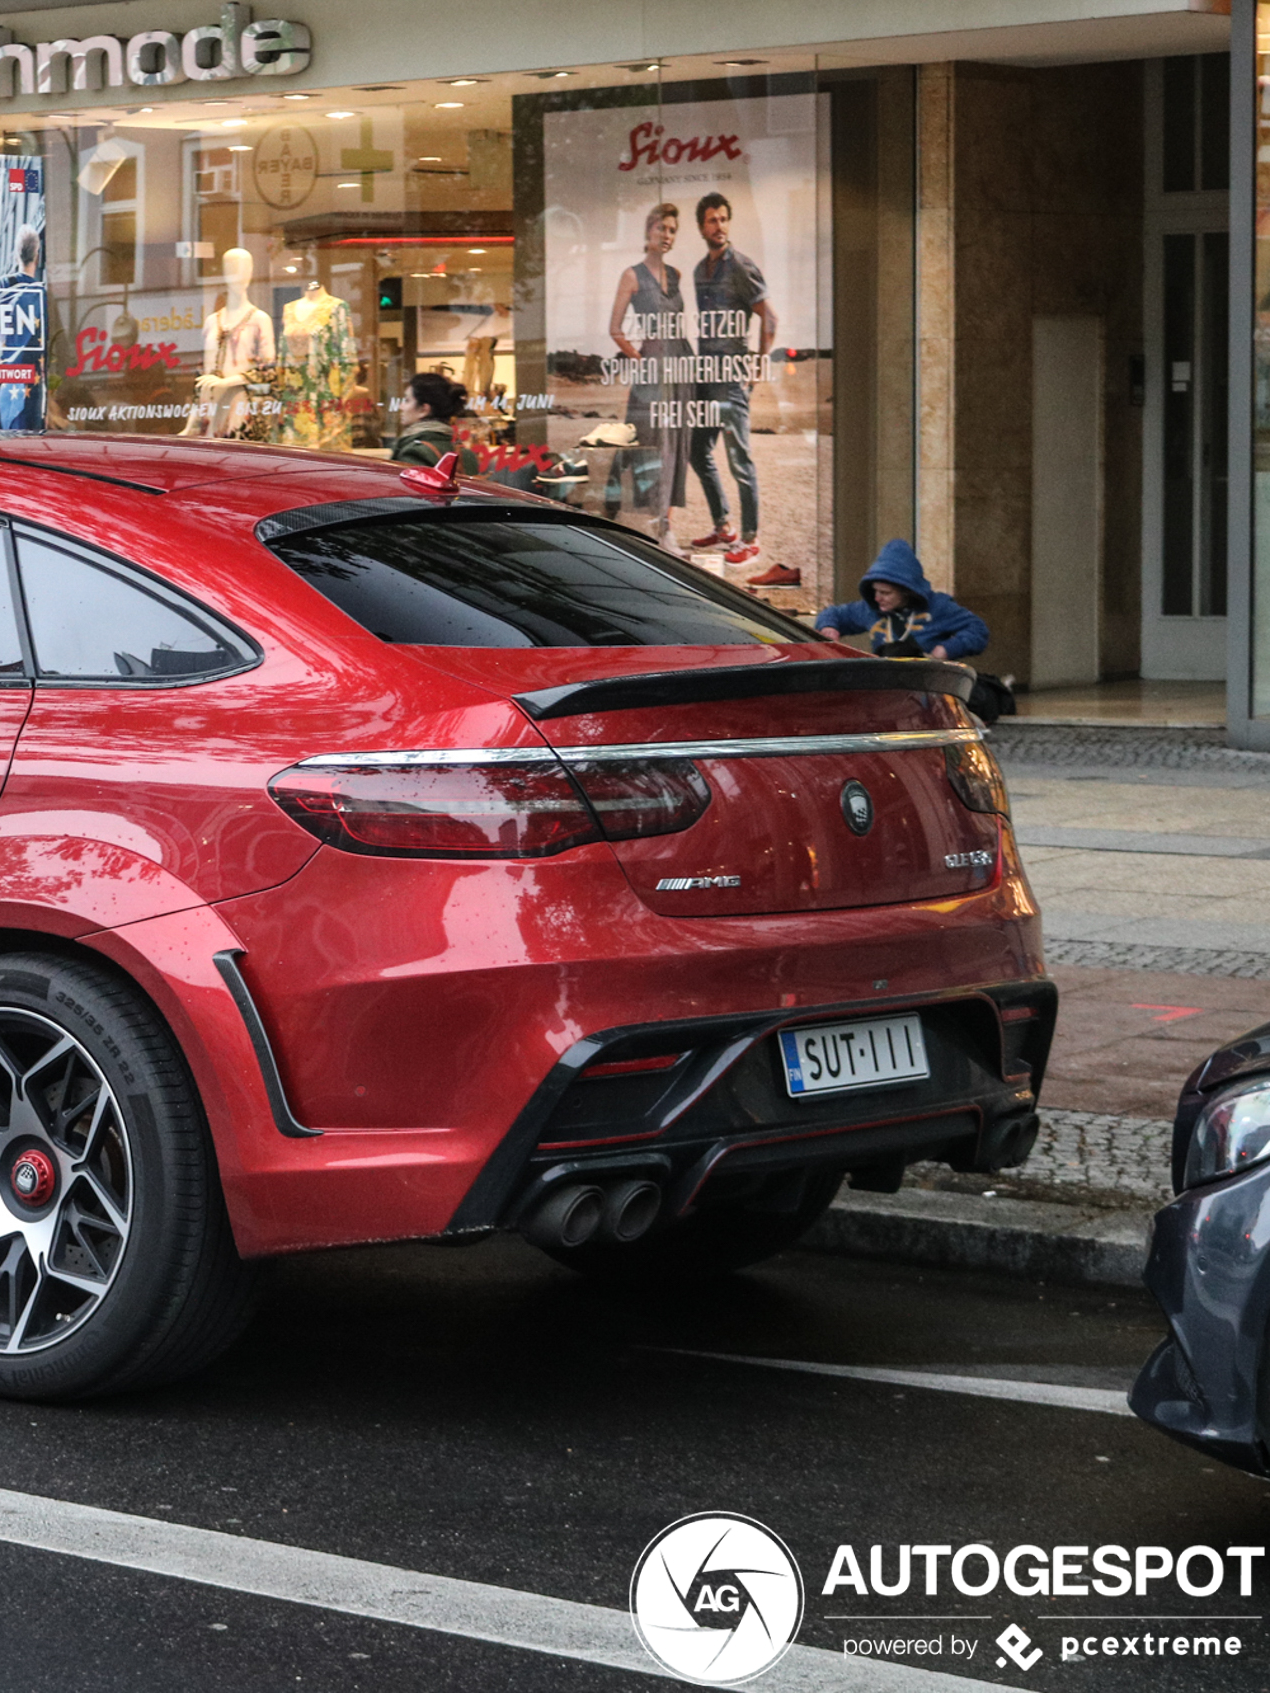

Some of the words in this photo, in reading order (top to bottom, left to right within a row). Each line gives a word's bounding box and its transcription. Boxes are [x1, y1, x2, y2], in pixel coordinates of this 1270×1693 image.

[618, 121, 742, 171] Sioux
[10, 182, 23, 191] SPD
[66, 327, 180, 377] Sioux
[600, 357, 658, 385] SPUREN
[663, 354, 776, 384] HINTERLASSEN.
[67, 406, 107, 421] SIOUX
[108, 403, 218, 420] AKTIONSWOCHEN
[235, 401, 257, 416] BIS
[517, 394, 555, 410] JUNI
[650, 401, 682, 428] FREI
[686, 400, 725, 428] SEIN.
[690, 875, 741, 889] AMG
